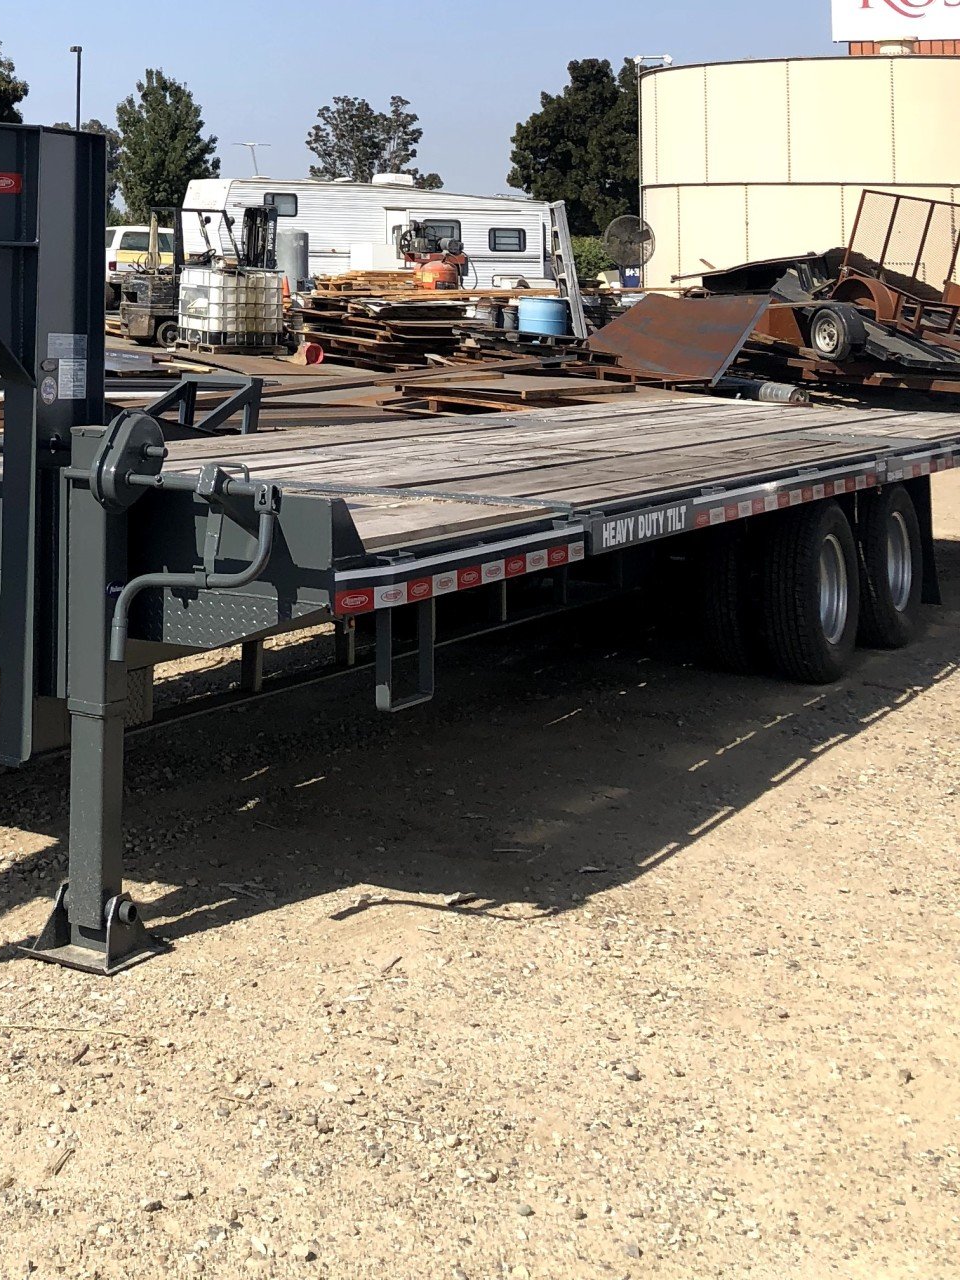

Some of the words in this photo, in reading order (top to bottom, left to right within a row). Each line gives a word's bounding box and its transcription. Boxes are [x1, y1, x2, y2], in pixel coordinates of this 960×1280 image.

[602, 517, 634, 547] HEAVY
[638, 510, 665, 539] DUTY
[667, 505, 687, 532] TILT
